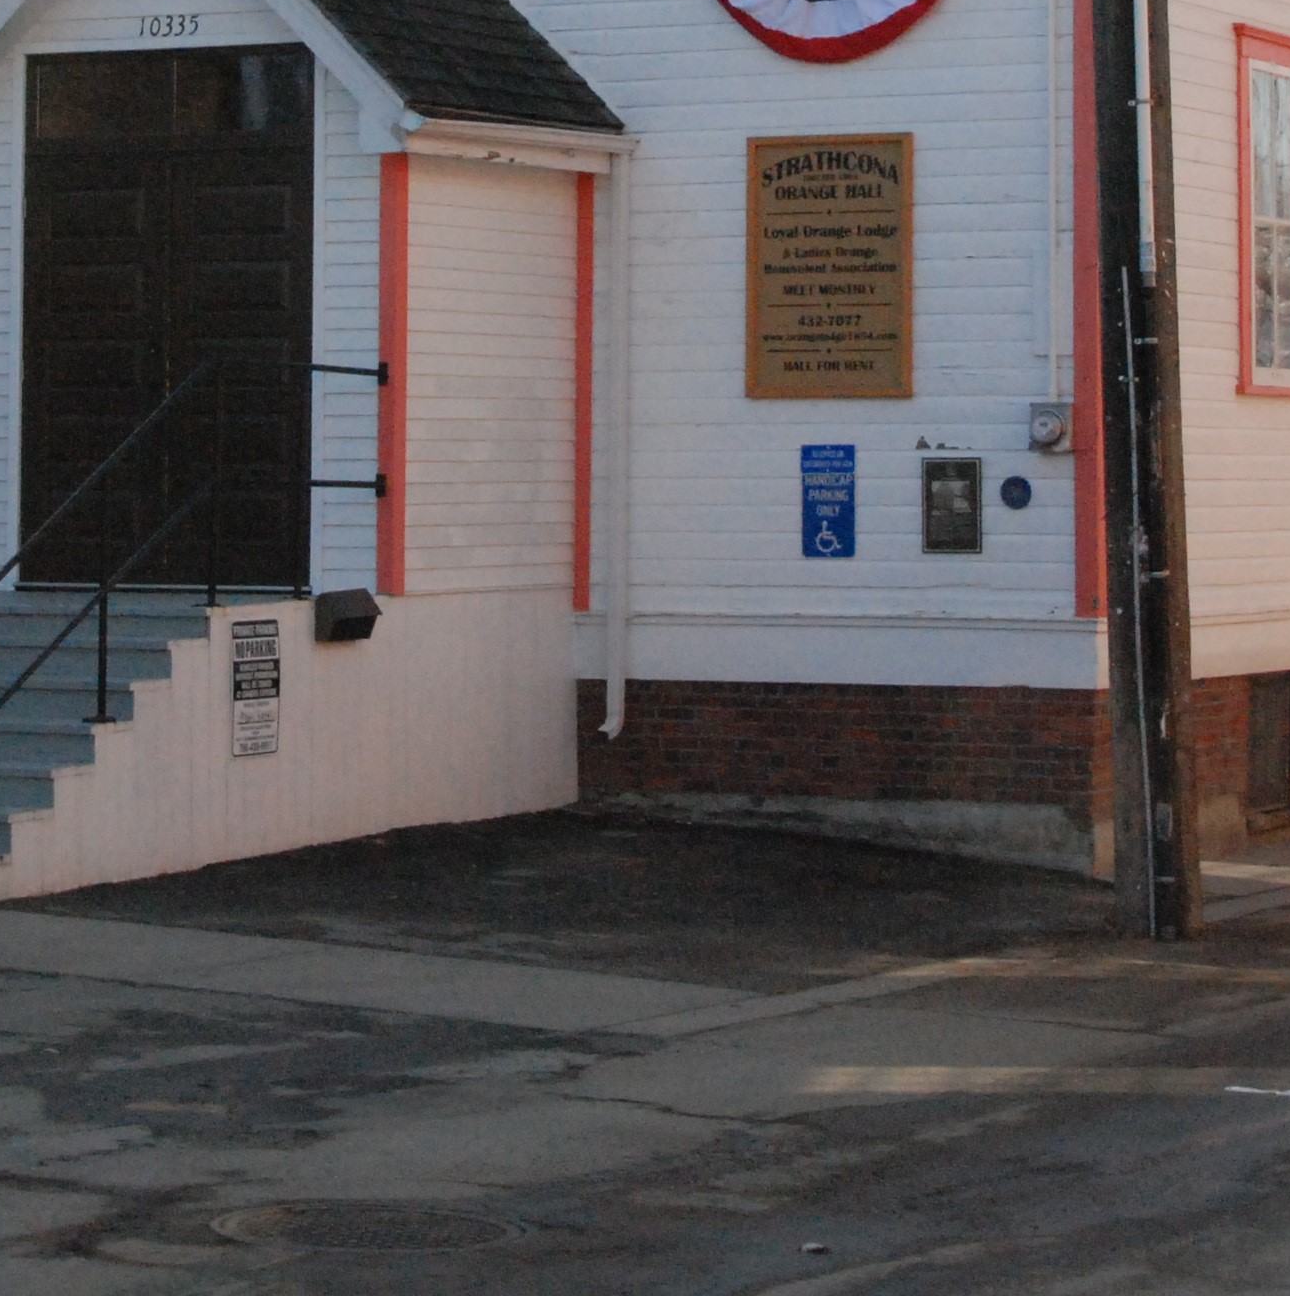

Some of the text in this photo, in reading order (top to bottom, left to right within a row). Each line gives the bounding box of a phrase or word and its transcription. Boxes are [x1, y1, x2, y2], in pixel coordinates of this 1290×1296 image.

[140, 14, 199, 37] 10335
[761, 150, 899, 188] STRATHCONA
[775, 183, 884, 201] ORANGE HALL
[764, 224, 897, 239] Loyal Orange Lodge
[836, 246, 878, 259] Orange
[830, 261, 897, 273] Association
[783, 284, 816, 296] MEET
[783, 360, 874, 372] HALL FOR RENT
[808, 489, 849, 501] PARKING
[816, 504, 839, 516] ONLY
[235, 638, 277, 659] NO PARKING
